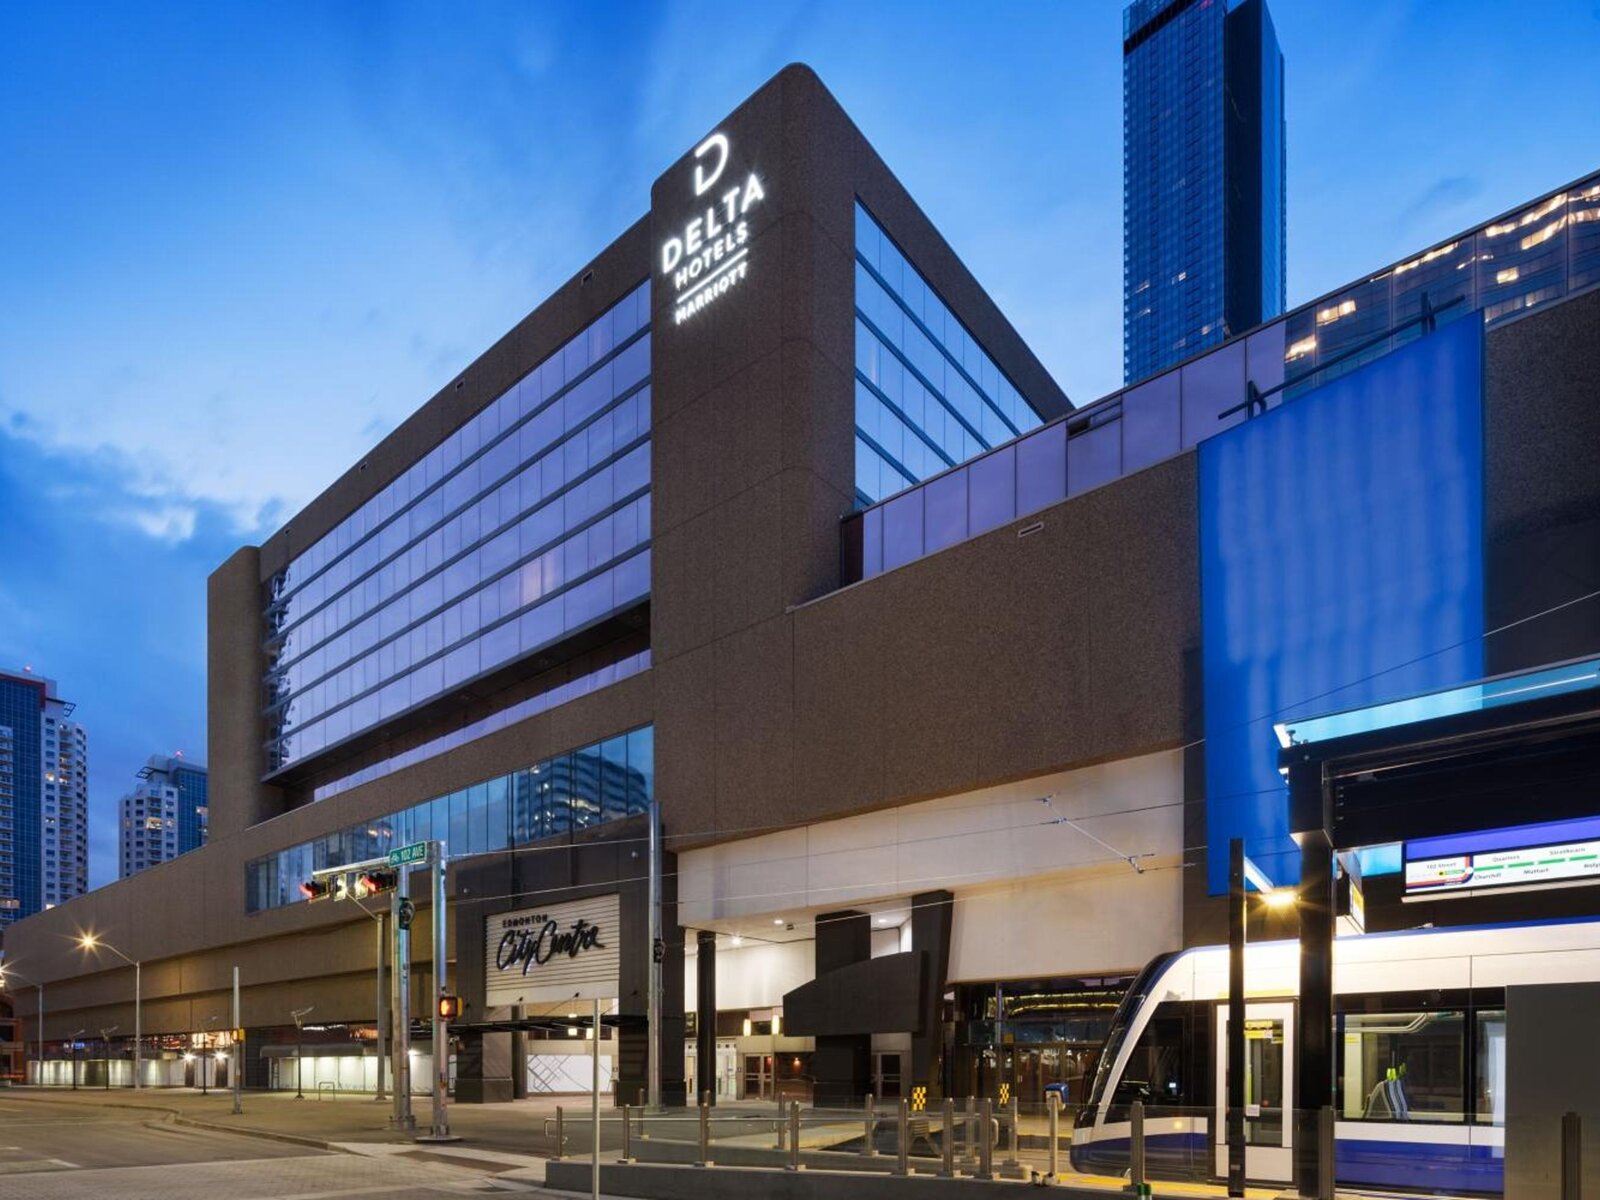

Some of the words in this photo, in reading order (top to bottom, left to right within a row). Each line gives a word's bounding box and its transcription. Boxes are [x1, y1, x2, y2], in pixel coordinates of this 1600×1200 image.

[662, 173, 765, 274] DELTA
[675, 221, 748, 290] HOTELS
[675, 261, 748, 325] MARRIOTT
[401, 848, 411, 861] 102
[411, 844, 424, 860] AVE
[502, 914, 549, 929] EDMONTON
